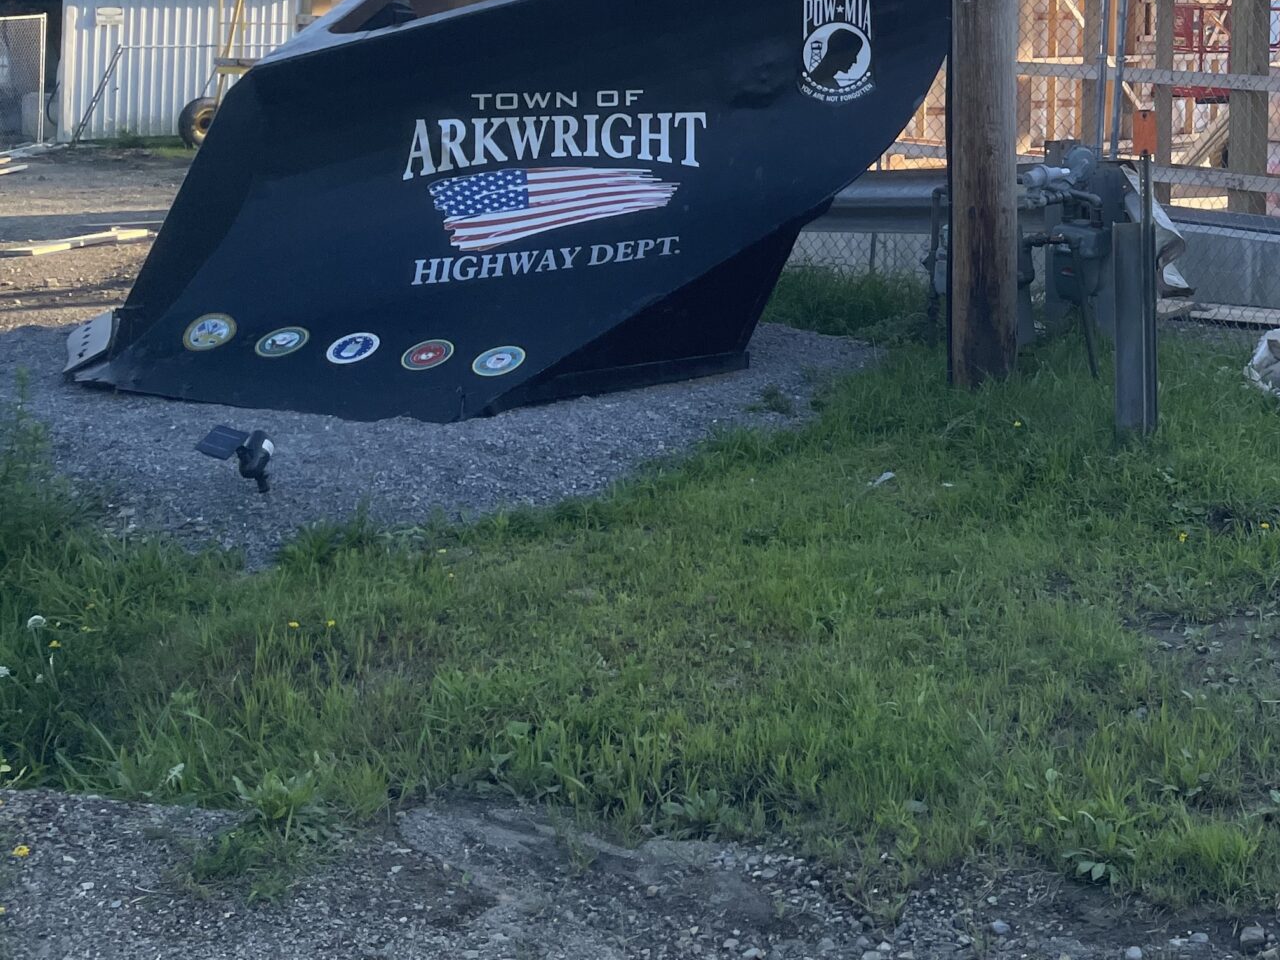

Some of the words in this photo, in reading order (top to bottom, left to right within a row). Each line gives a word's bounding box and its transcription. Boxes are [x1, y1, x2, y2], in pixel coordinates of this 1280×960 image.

[470, 90, 578, 111] TOWN
[596, 89, 644, 107] OF
[801, 83, 813, 95] YOU
[812, 92, 825, 102] ARE
[840, 83, 873, 102] FORGOTTEN
[402, 111, 707, 181] ARKWRIGHT
[410, 245, 582, 286] HIGHWAY
[587, 236, 682, 267] DEPT.
